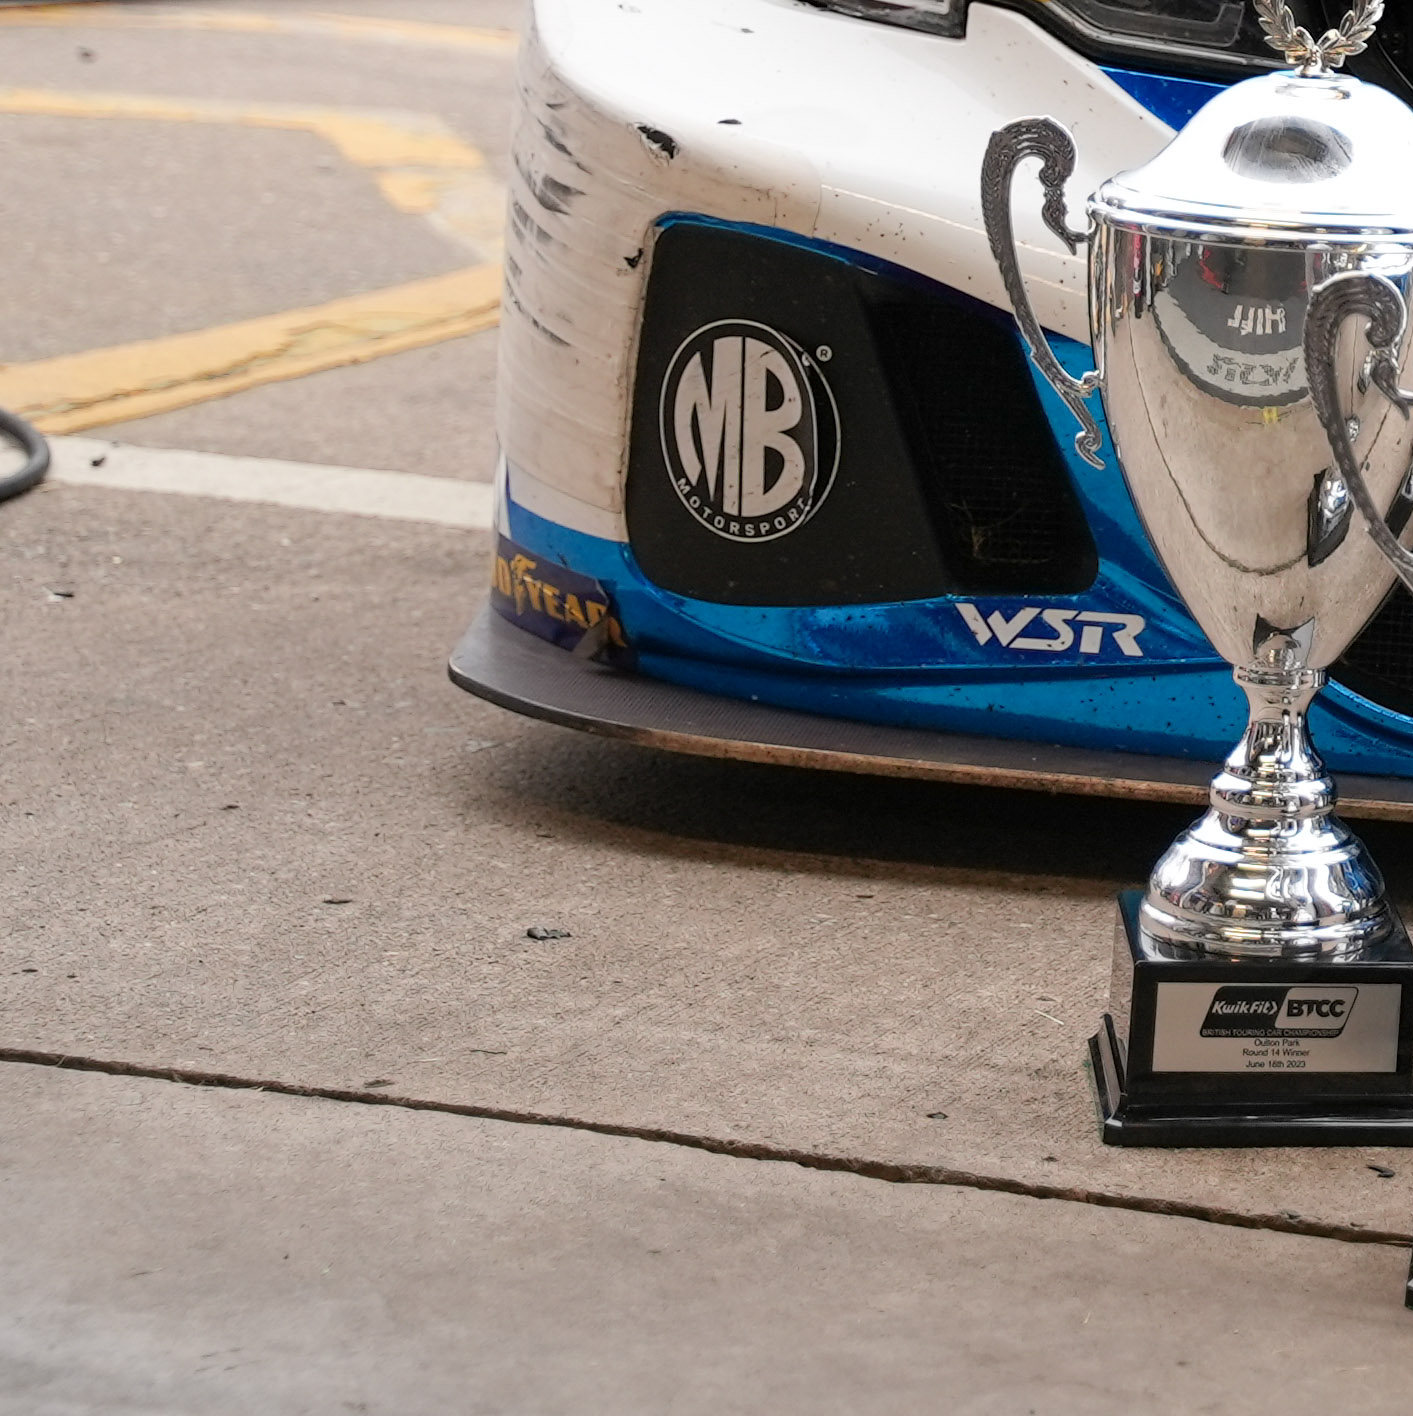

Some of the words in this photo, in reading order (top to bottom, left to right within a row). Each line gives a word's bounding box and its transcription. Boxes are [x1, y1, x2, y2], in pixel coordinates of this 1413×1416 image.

[673, 335, 806, 518] MB
[676, 476, 813, 539] MOTORSPORT
[953, 601, 1147, 658] WSR
[1287, 999, 1346, 1018] BTCC
[1282, 1038, 1300, 1047] Park
[1242, 1048, 1268, 1057] Round
[1271, 1048, 1280, 1057] 14
[1282, 1048, 1310, 1057] Winner
[1246, 1060, 1265, 1069] June
[1286, 1060, 1306, 1069] 2023
